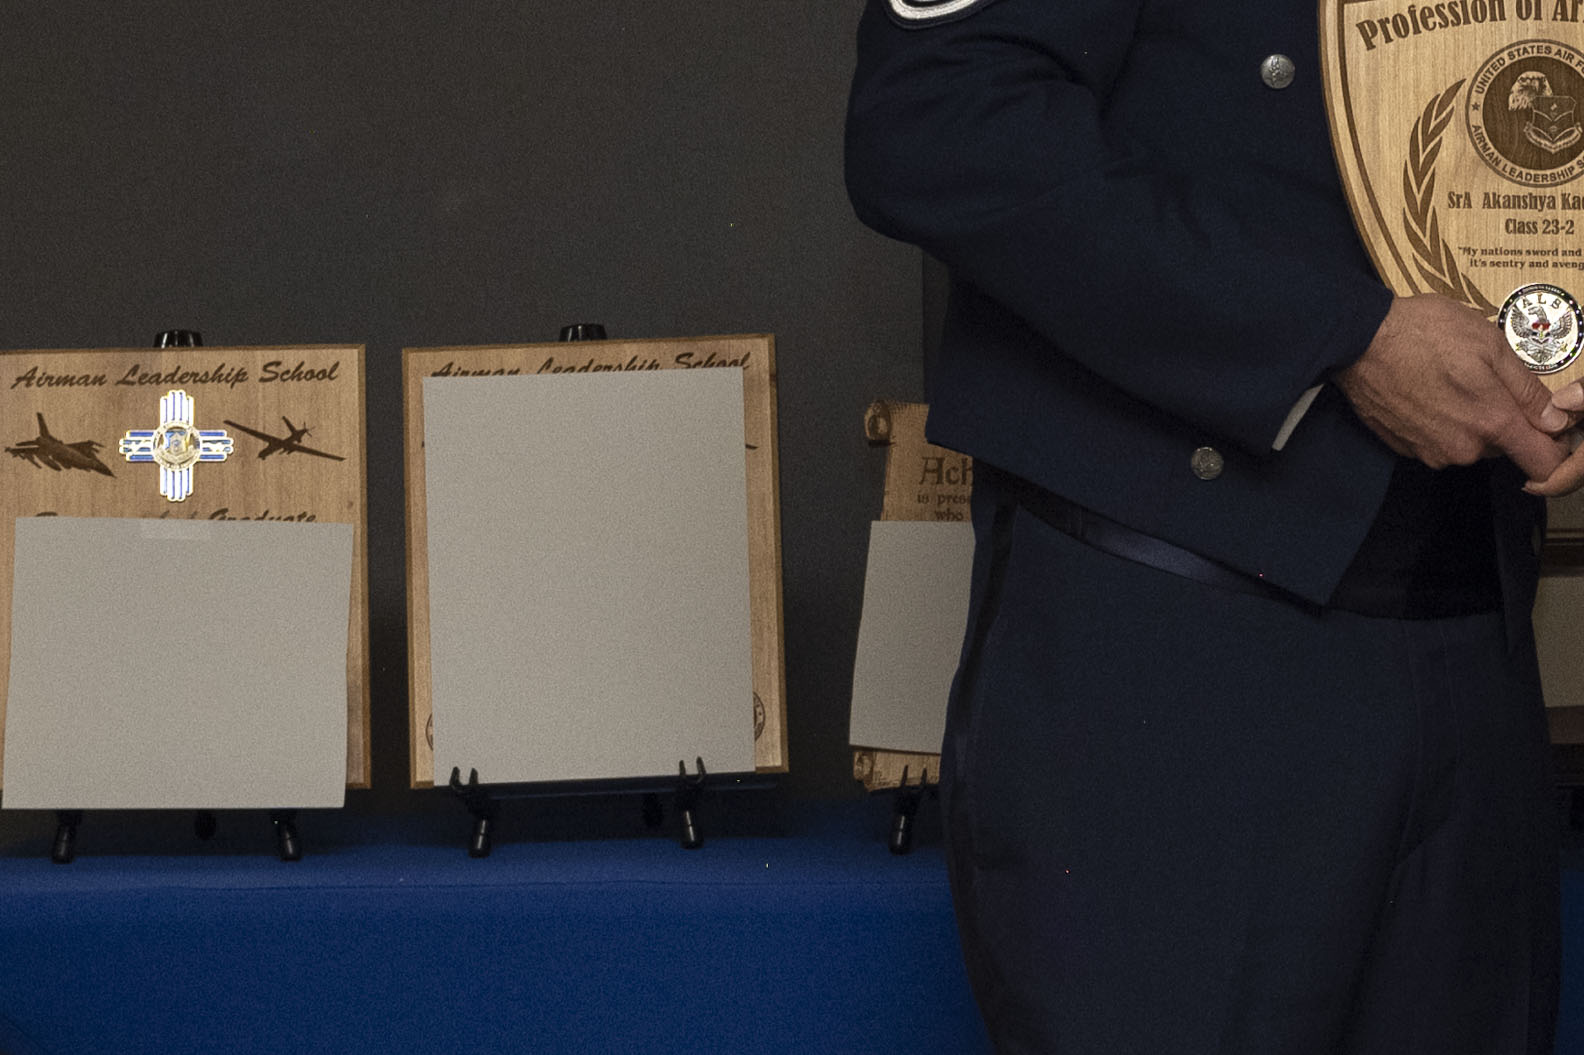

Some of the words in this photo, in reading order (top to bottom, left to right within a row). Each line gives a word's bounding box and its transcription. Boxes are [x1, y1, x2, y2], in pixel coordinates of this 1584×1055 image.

[1475, 57, 1506, 95] UNITED
[1507, 45, 1552, 60] STATES
[1554, 47, 1575, 64] AIR
[1472, 124, 1502, 167] AIRMAN
[1502, 163, 1575, 183] LEADERSHIP
[1448, 191, 1473, 209] SrA
[1505, 218, 1538, 235] Class
[1542, 219, 1575, 235] 23-2
[1481, 246, 1523, 257] nations
[1525, 247, 1559, 257] sword
[1561, 247, 1582, 257] and
[1489, 260, 1525, 270] sentry
[1528, 259, 1549, 269] and
[11, 366, 108, 389] Airman
[115, 362, 250, 389] Leadership
[258, 360, 340, 383] School
